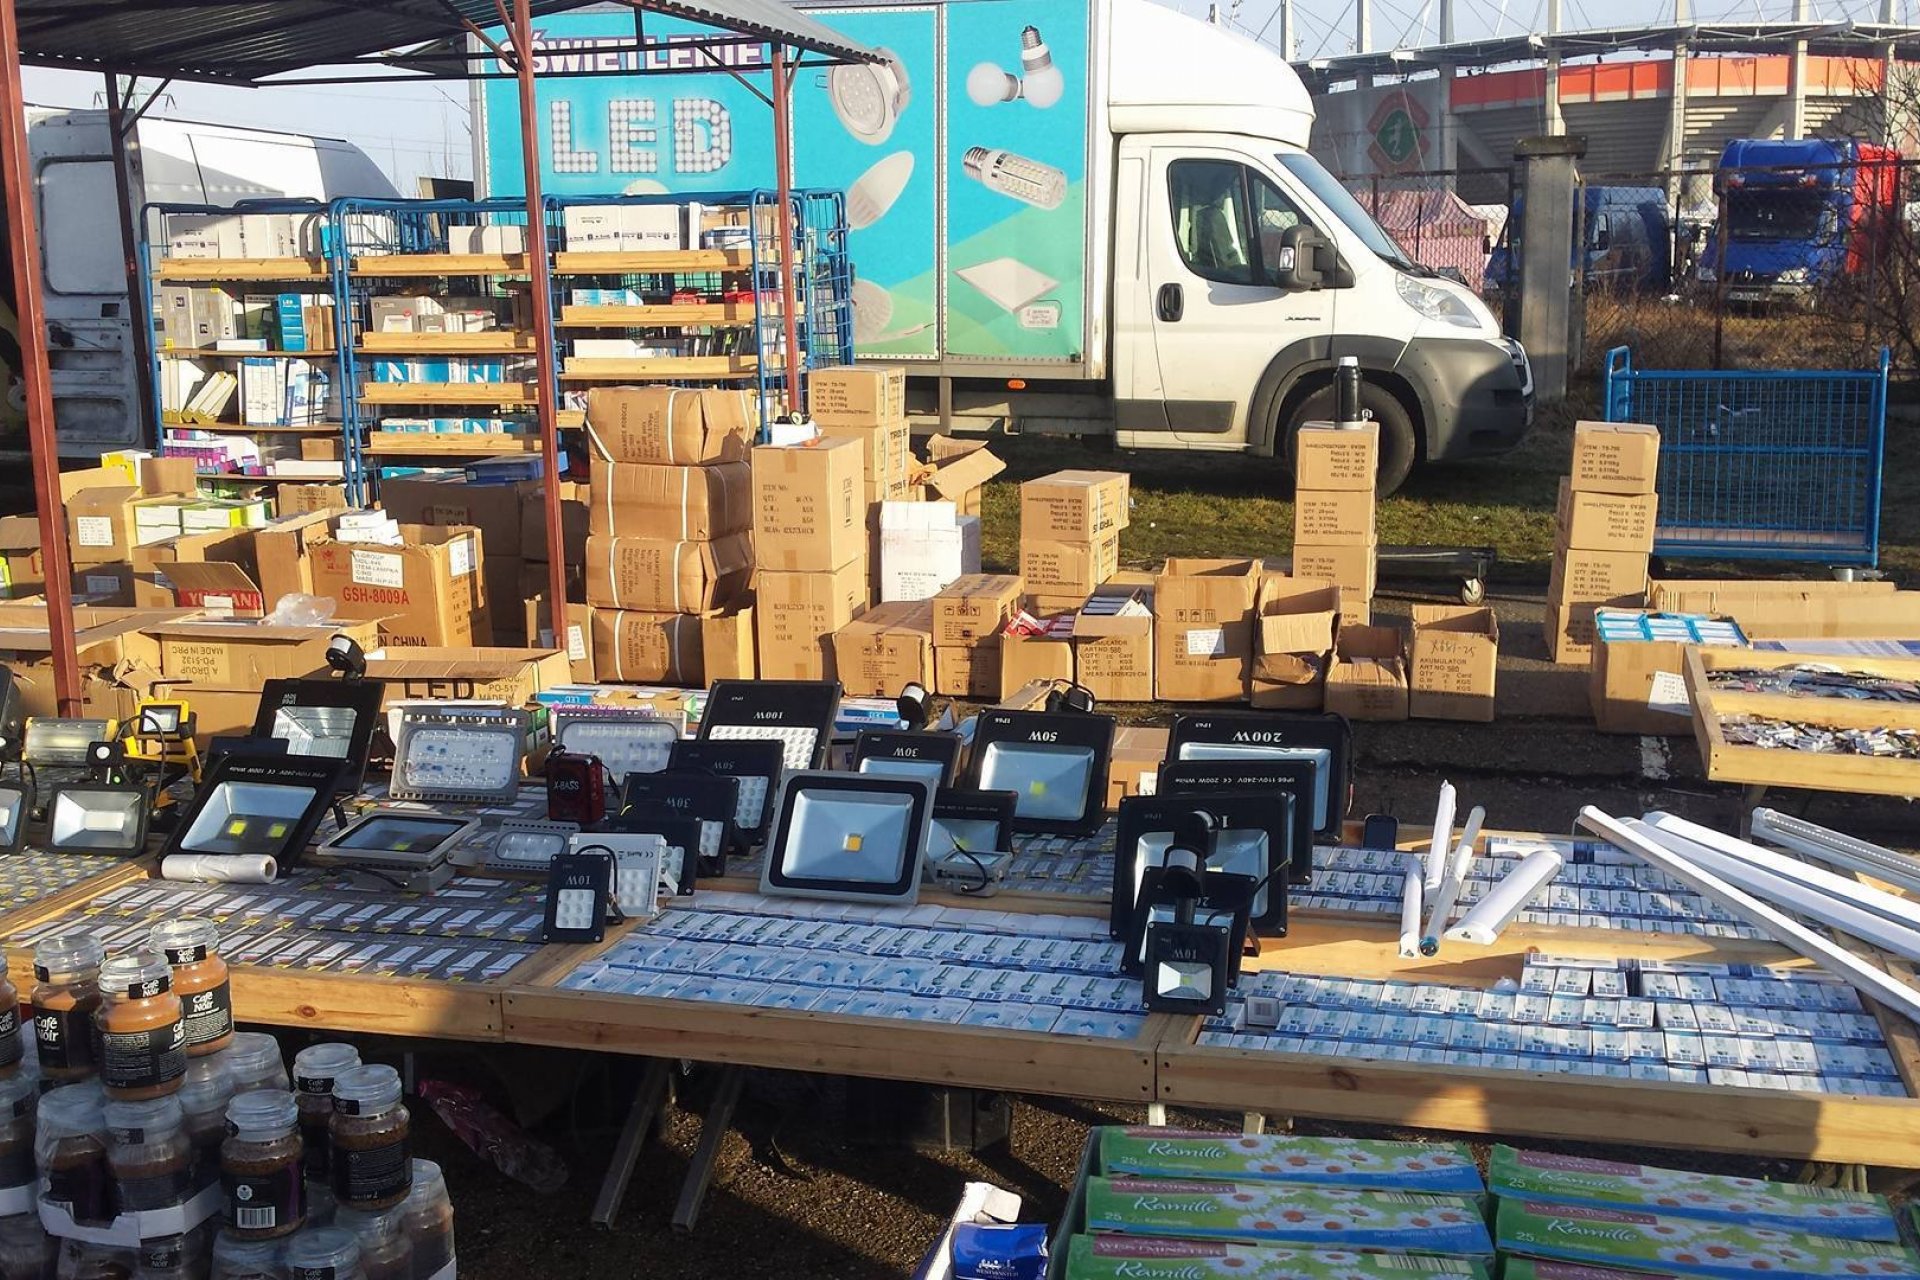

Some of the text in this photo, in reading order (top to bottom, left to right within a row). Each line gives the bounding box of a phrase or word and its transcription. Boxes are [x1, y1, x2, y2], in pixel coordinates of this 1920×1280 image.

[551, 99, 731, 174] LED
[342, 586, 410, 605] GSH-8009A
[392, 635, 428, 648] CHINA
[172, 646, 223, 655] MADE IN PRC
[180, 666, 211, 675] GROUP
[403, 678, 475, 700] LED
[564, 695, 580, 703] LED
[753, 711, 784, 720] 100W
[1028, 730, 1059, 742] 50W
[1232, 730, 1283, 743] 200W
[893, 747, 919, 758] 30W
[553, 780, 580, 790] X-BASS
[665, 797, 692, 808] 30W
[566, 876, 591, 885] 10W
[178, 954, 195, 963] Noir
[1172, 949, 1197, 960] 10W
[142, 987, 160, 998] Noir
[193, 1001, 214, 1013] Noir
[35, 1015, 58, 1030] Café
[39, 1029, 60, 1043] Noir
[1147, 1141, 1227, 1159] Kamille
[1509, 1176, 1526, 1188] 25
[1538, 1170, 1623, 1190] Kamille
[1134, 1196, 1218, 1213] Kamille
[1104, 1211, 1122, 1221] 25
[1516, 1231, 1535, 1242] 25
[1547, 1219, 1638, 1242] Kamille
[1115, 1260, 1206, 1280] Kamille
